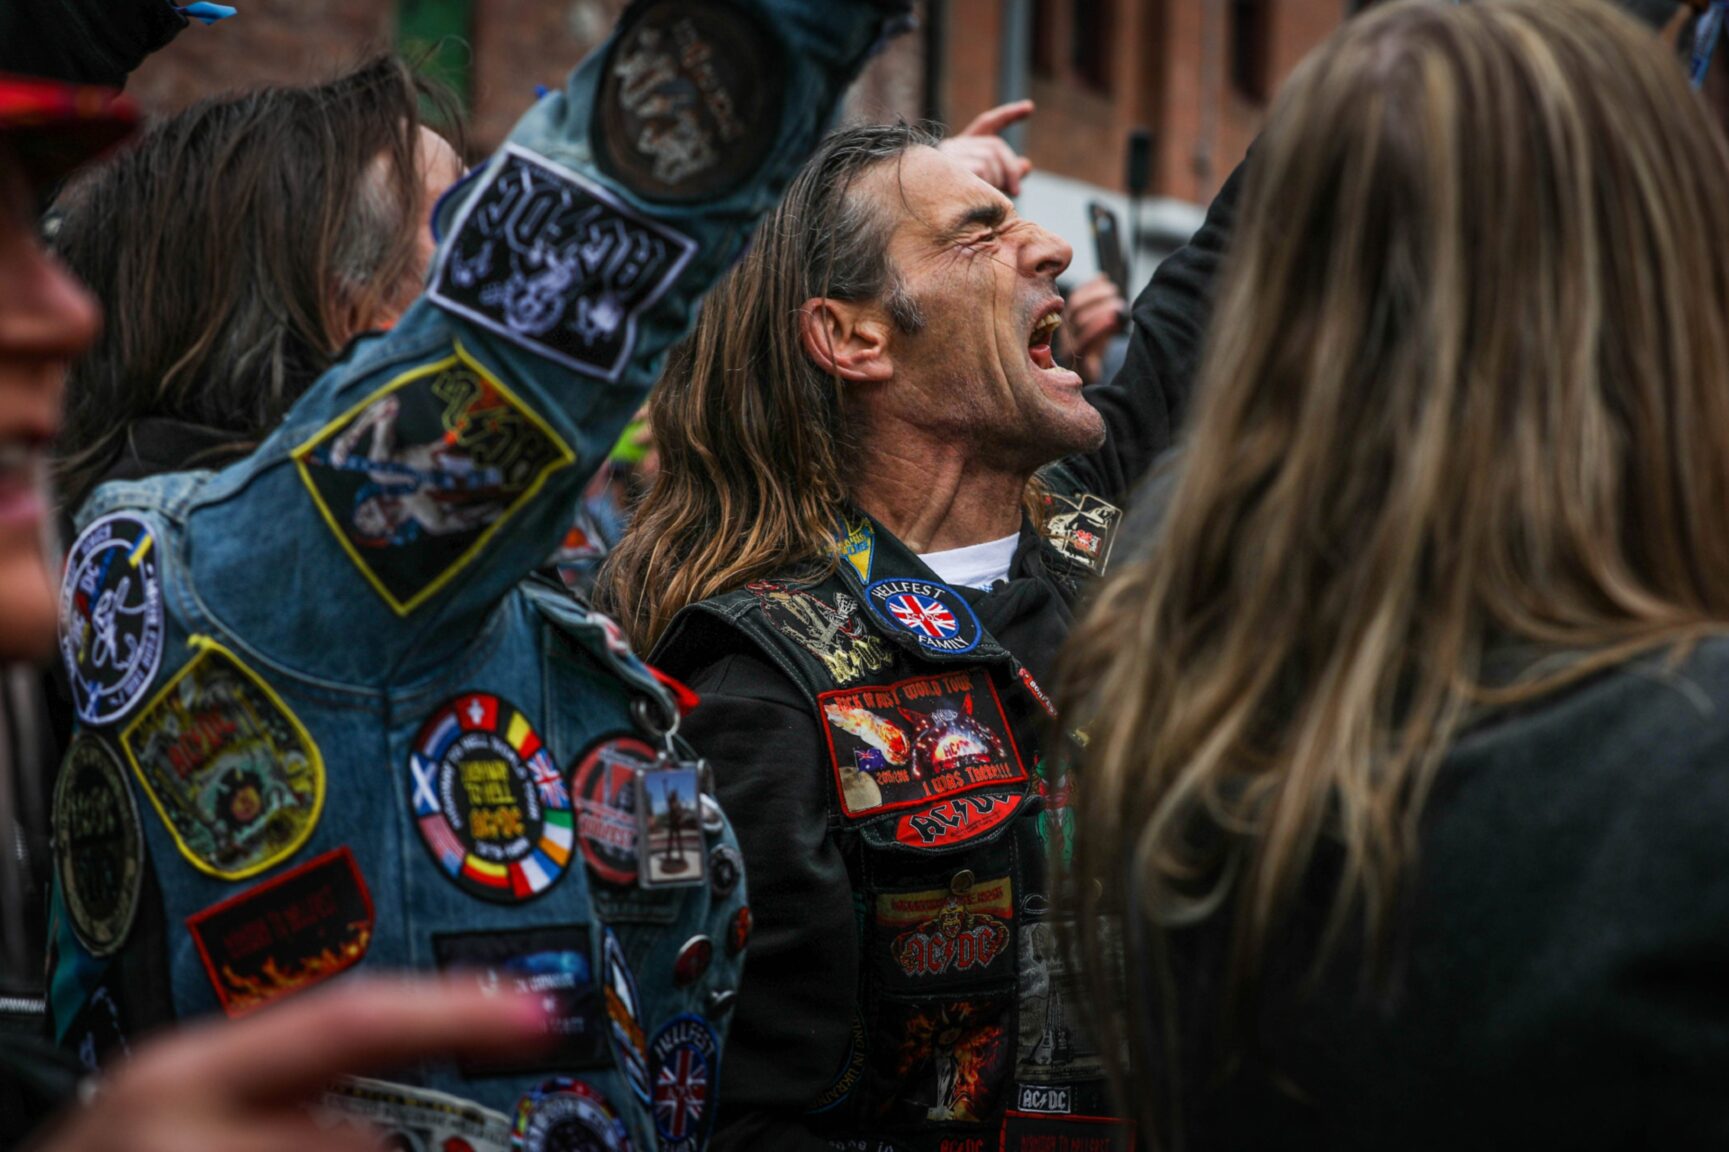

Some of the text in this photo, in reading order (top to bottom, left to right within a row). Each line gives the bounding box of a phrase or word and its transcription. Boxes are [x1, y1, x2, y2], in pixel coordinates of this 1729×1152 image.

[871, 582, 946, 600] HELLFEST
[918, 634, 970, 651] FAMILY
[902, 680, 942, 700] WORLD
[943, 674, 974, 694] TOUR
[922, 780, 932, 796] I
[931, 770, 965, 794] WAS
[901, 926, 995, 976] AC/DC
[1023, 1089, 1067, 1109] AC/DC
